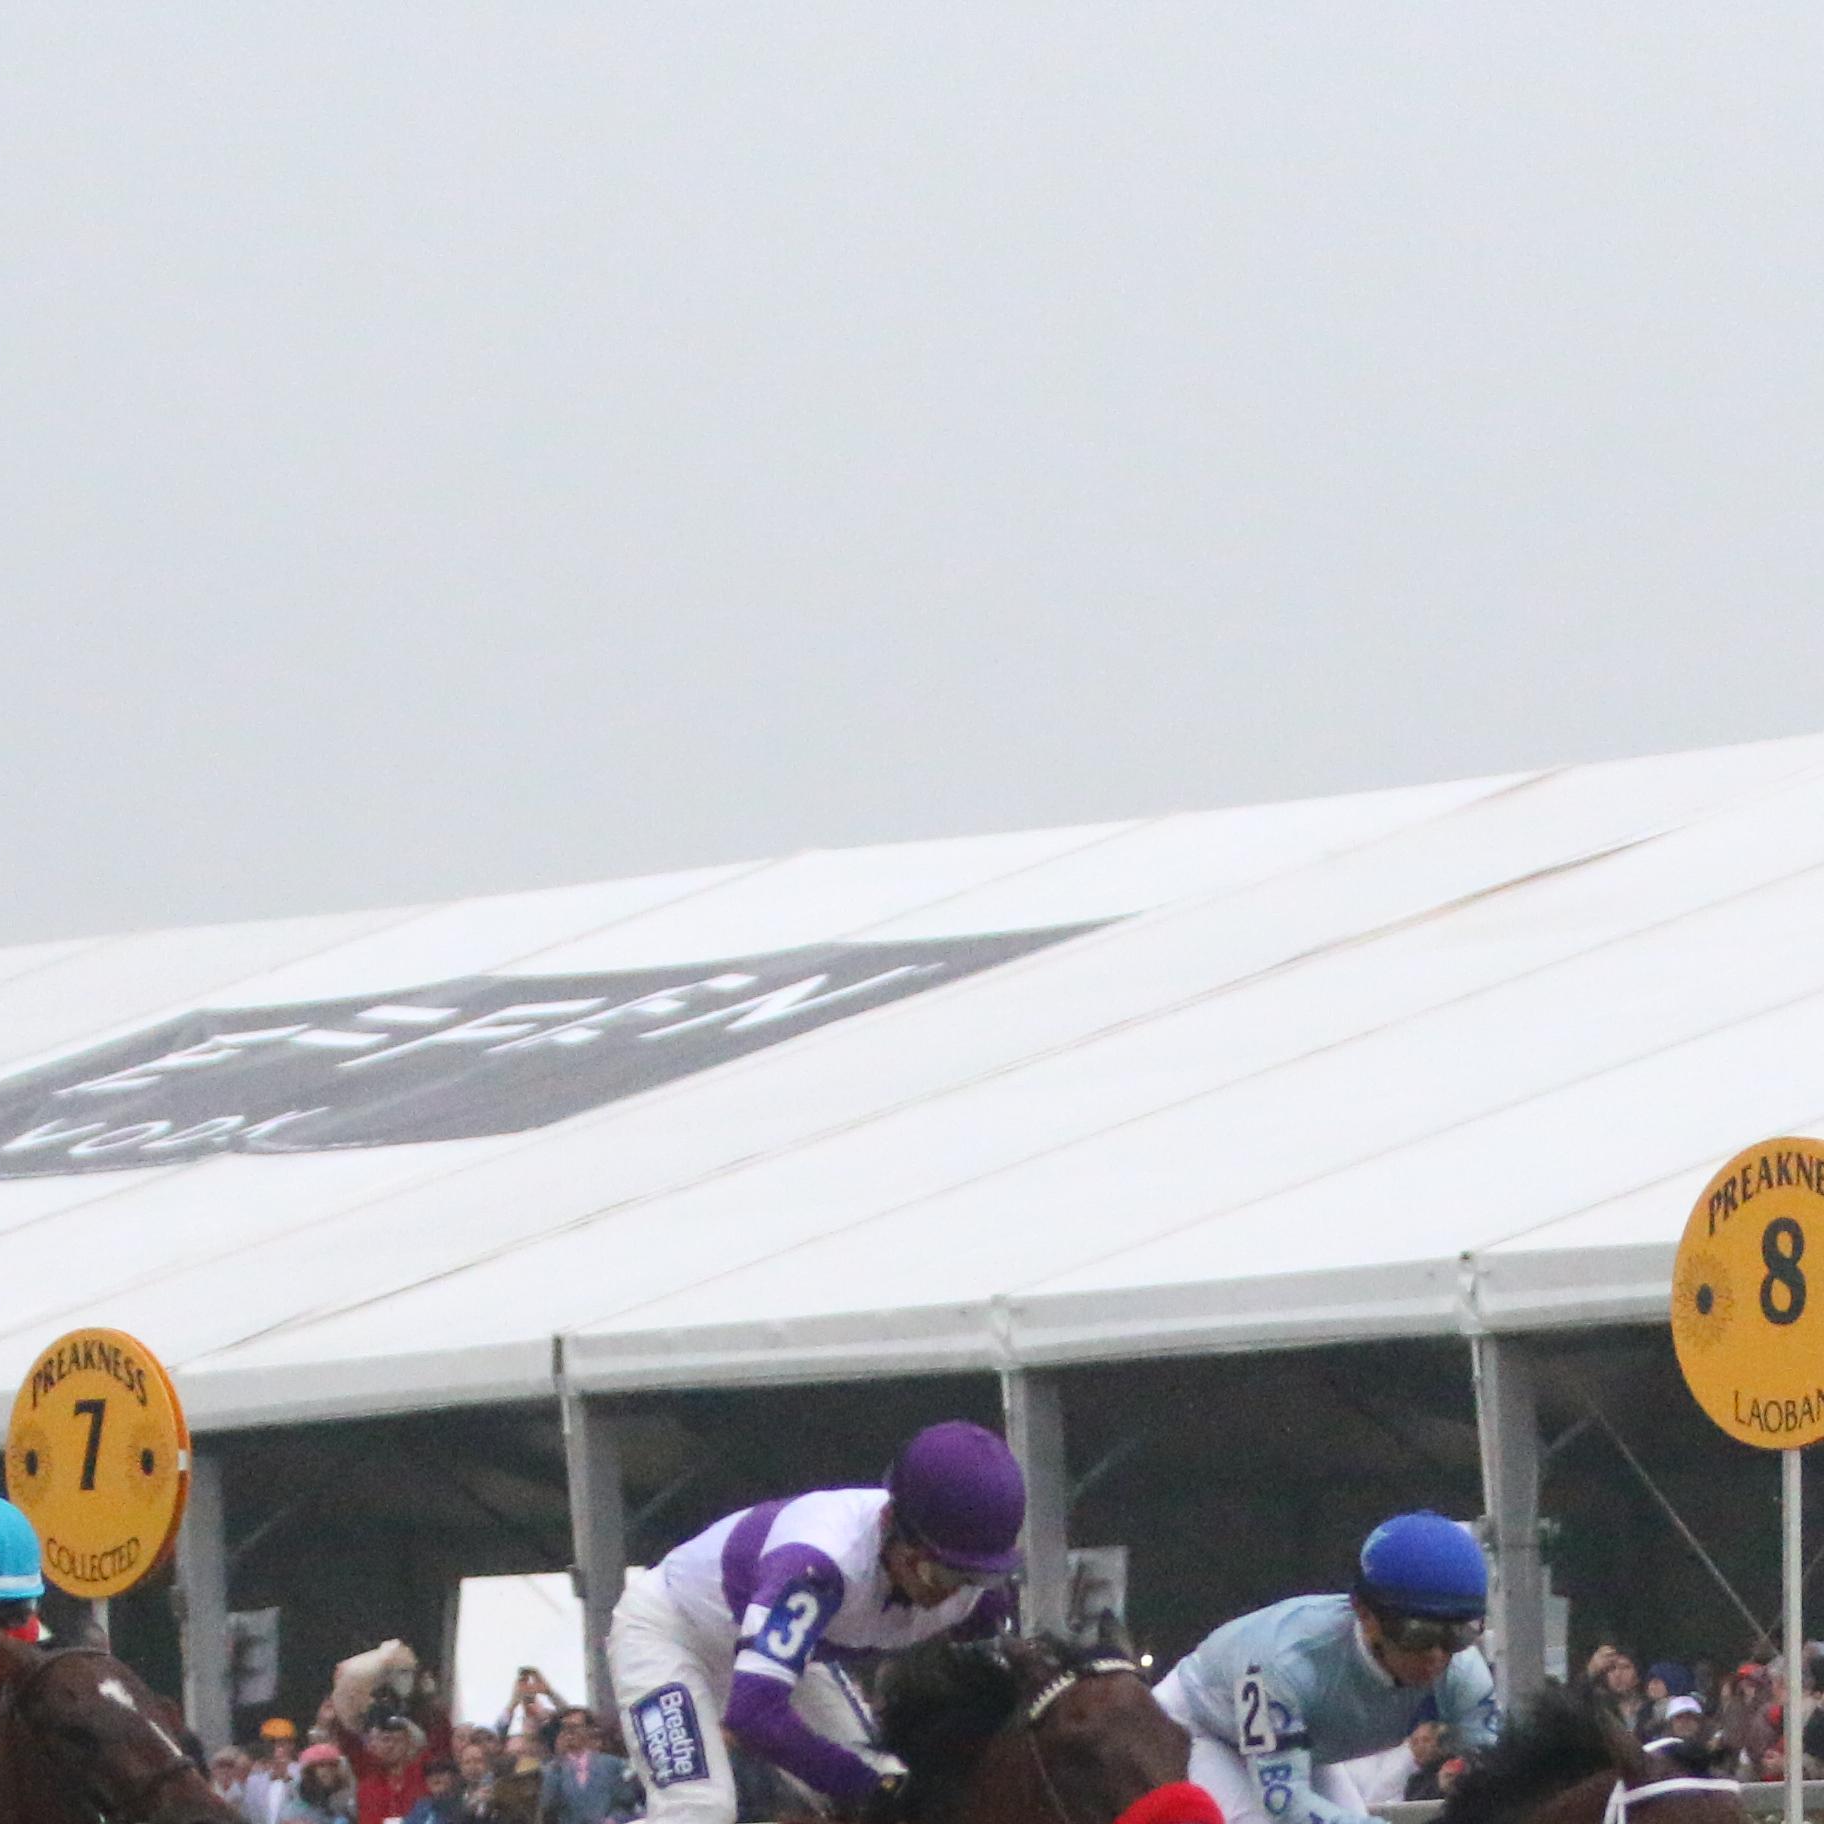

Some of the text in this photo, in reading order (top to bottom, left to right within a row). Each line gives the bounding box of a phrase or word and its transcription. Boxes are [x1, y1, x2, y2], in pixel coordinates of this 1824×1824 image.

[1759, 1217, 1807, 1325] 8
[30, 1340, 147, 1411] PREAKNESS
[73, 1399, 107, 1490] 7
[46, 1537, 141, 1582] COLLECTED
[767, 1591, 819, 1659] 3
[660, 1691, 695, 1776] Breathe
[1242, 1681, 1265, 1746] 2
